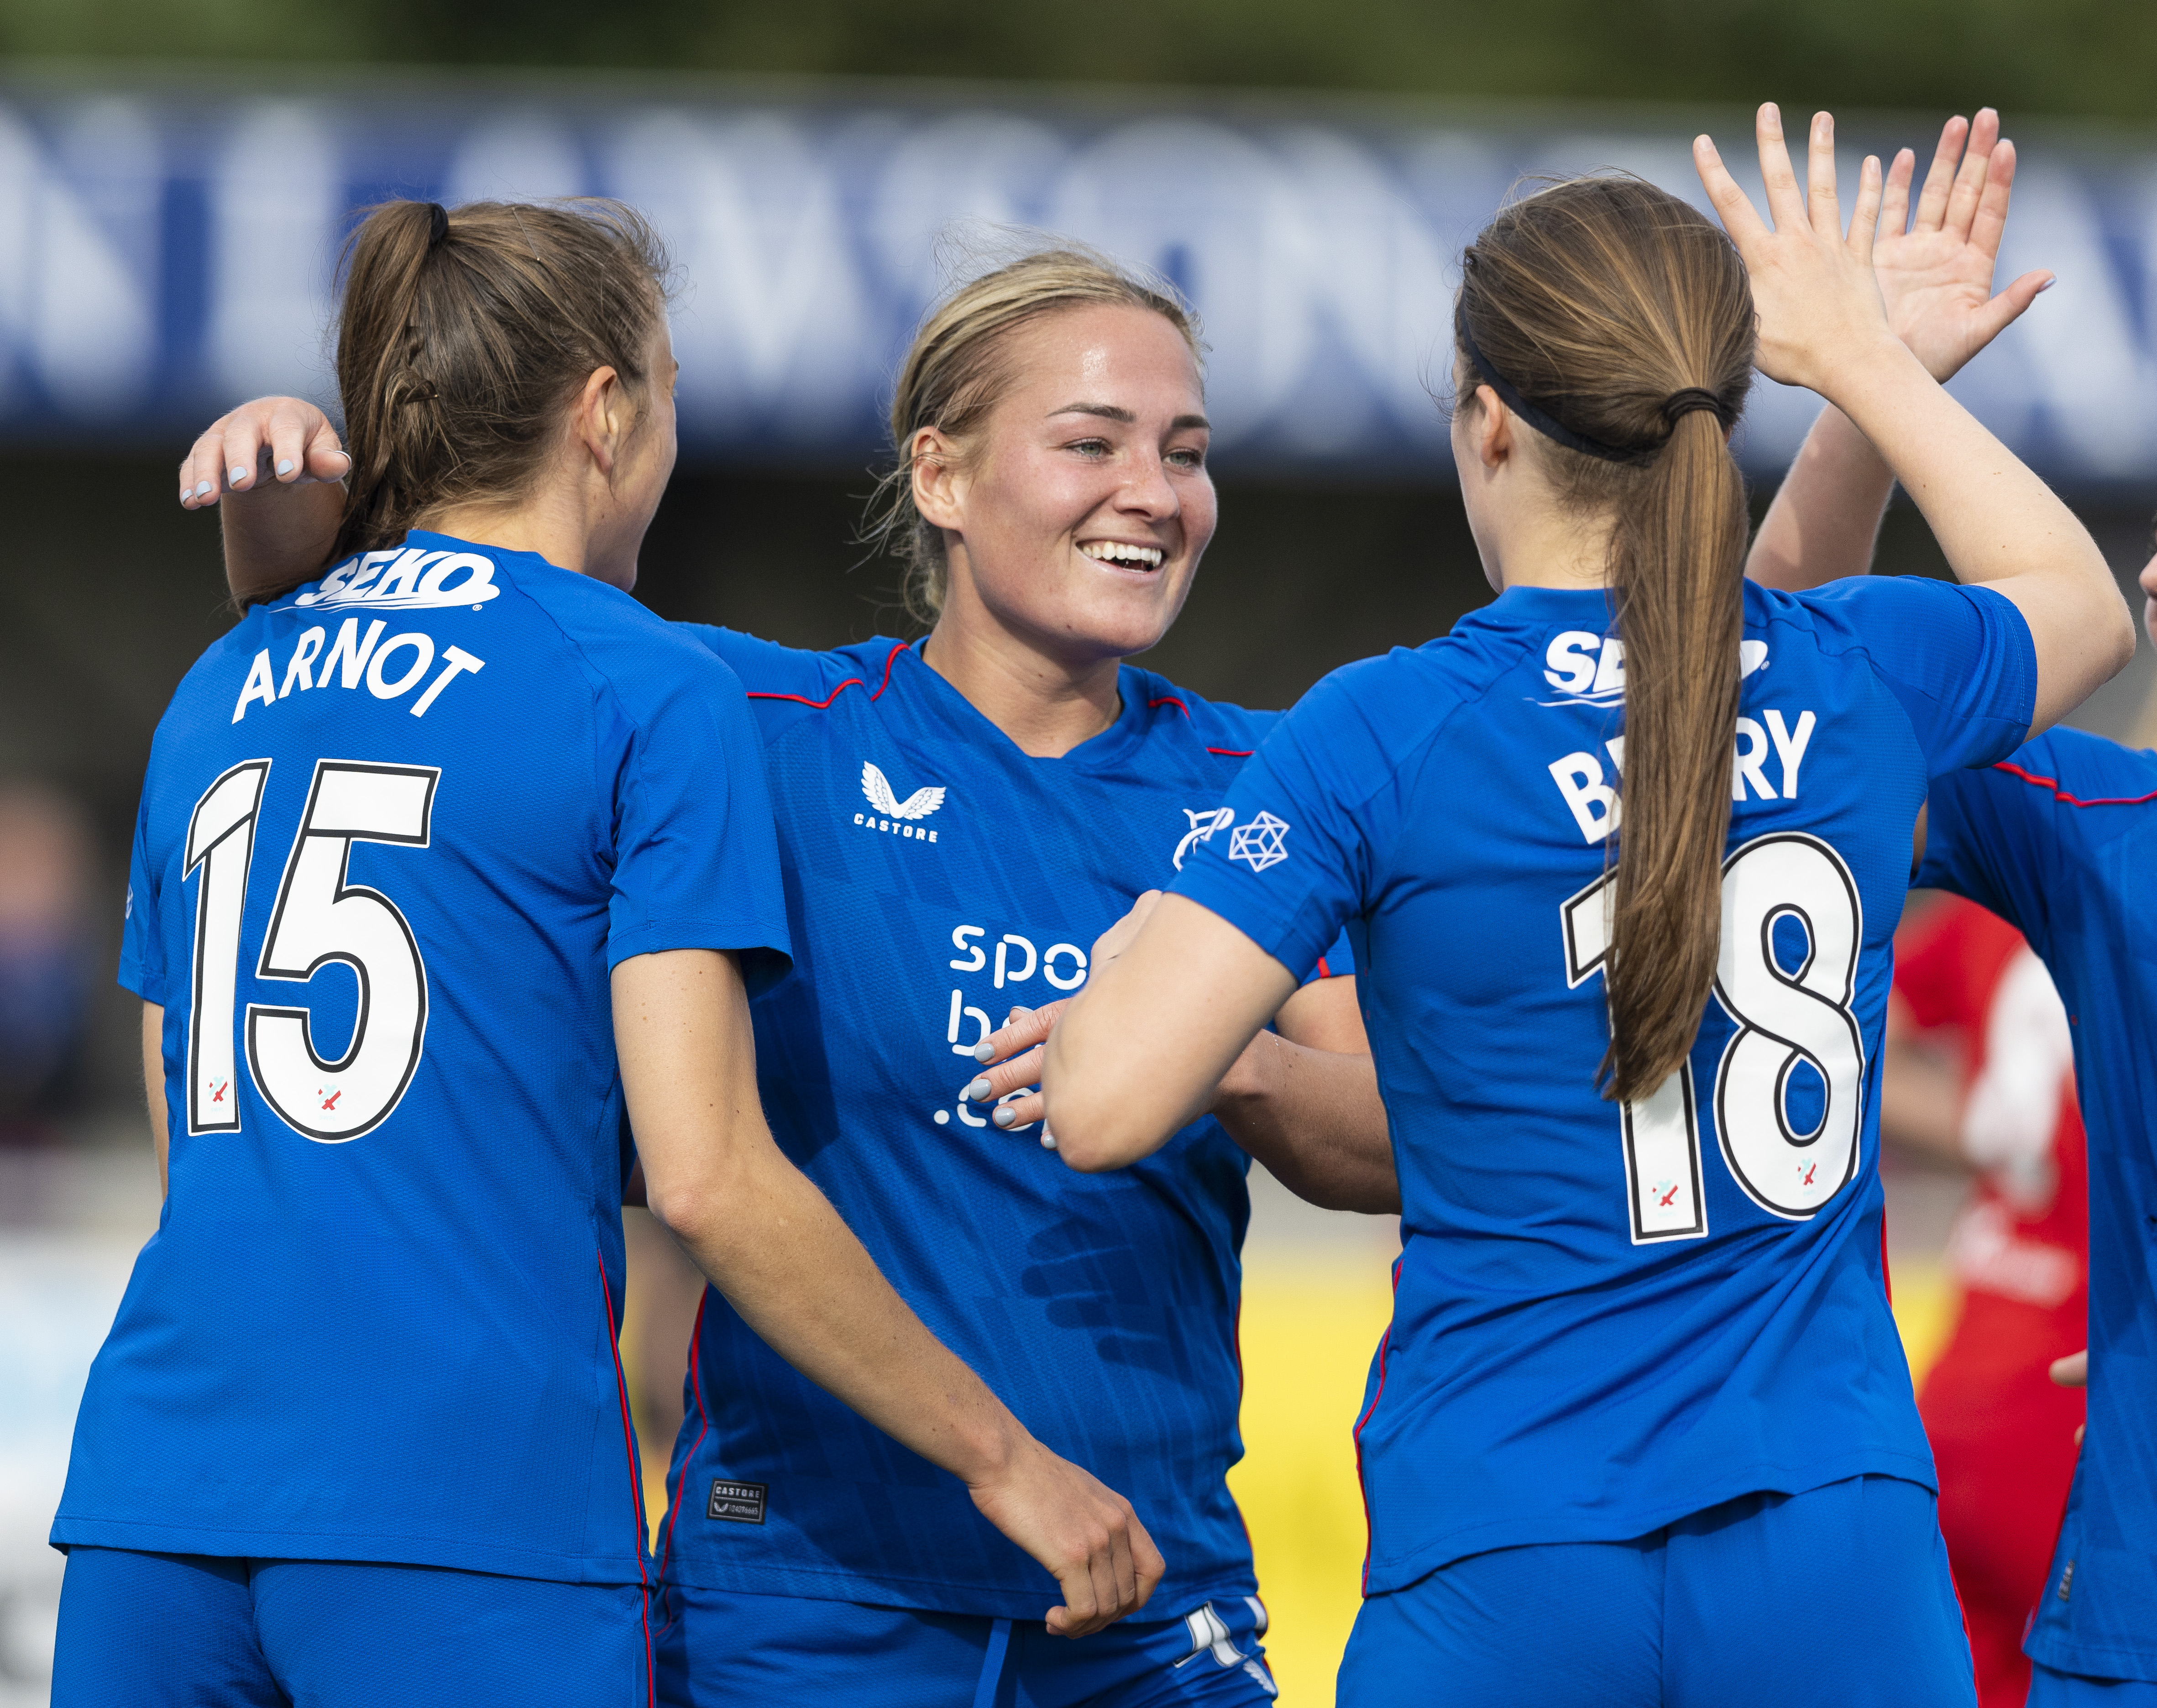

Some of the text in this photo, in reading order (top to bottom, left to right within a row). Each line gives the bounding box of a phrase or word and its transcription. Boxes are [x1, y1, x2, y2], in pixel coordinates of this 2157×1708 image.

[293, 548, 500, 613] SEKO
[232, 618, 486, 724] ARNOT
[1543, 630, 1768, 694] SE
[1548, 709, 1817, 844] BRY
[853, 813, 938, 844] CASTORE
[183, 757, 442, 1144] 15
[1560, 831, 1866, 1246] 18
[716, 1486, 760, 1498] CASTORE
